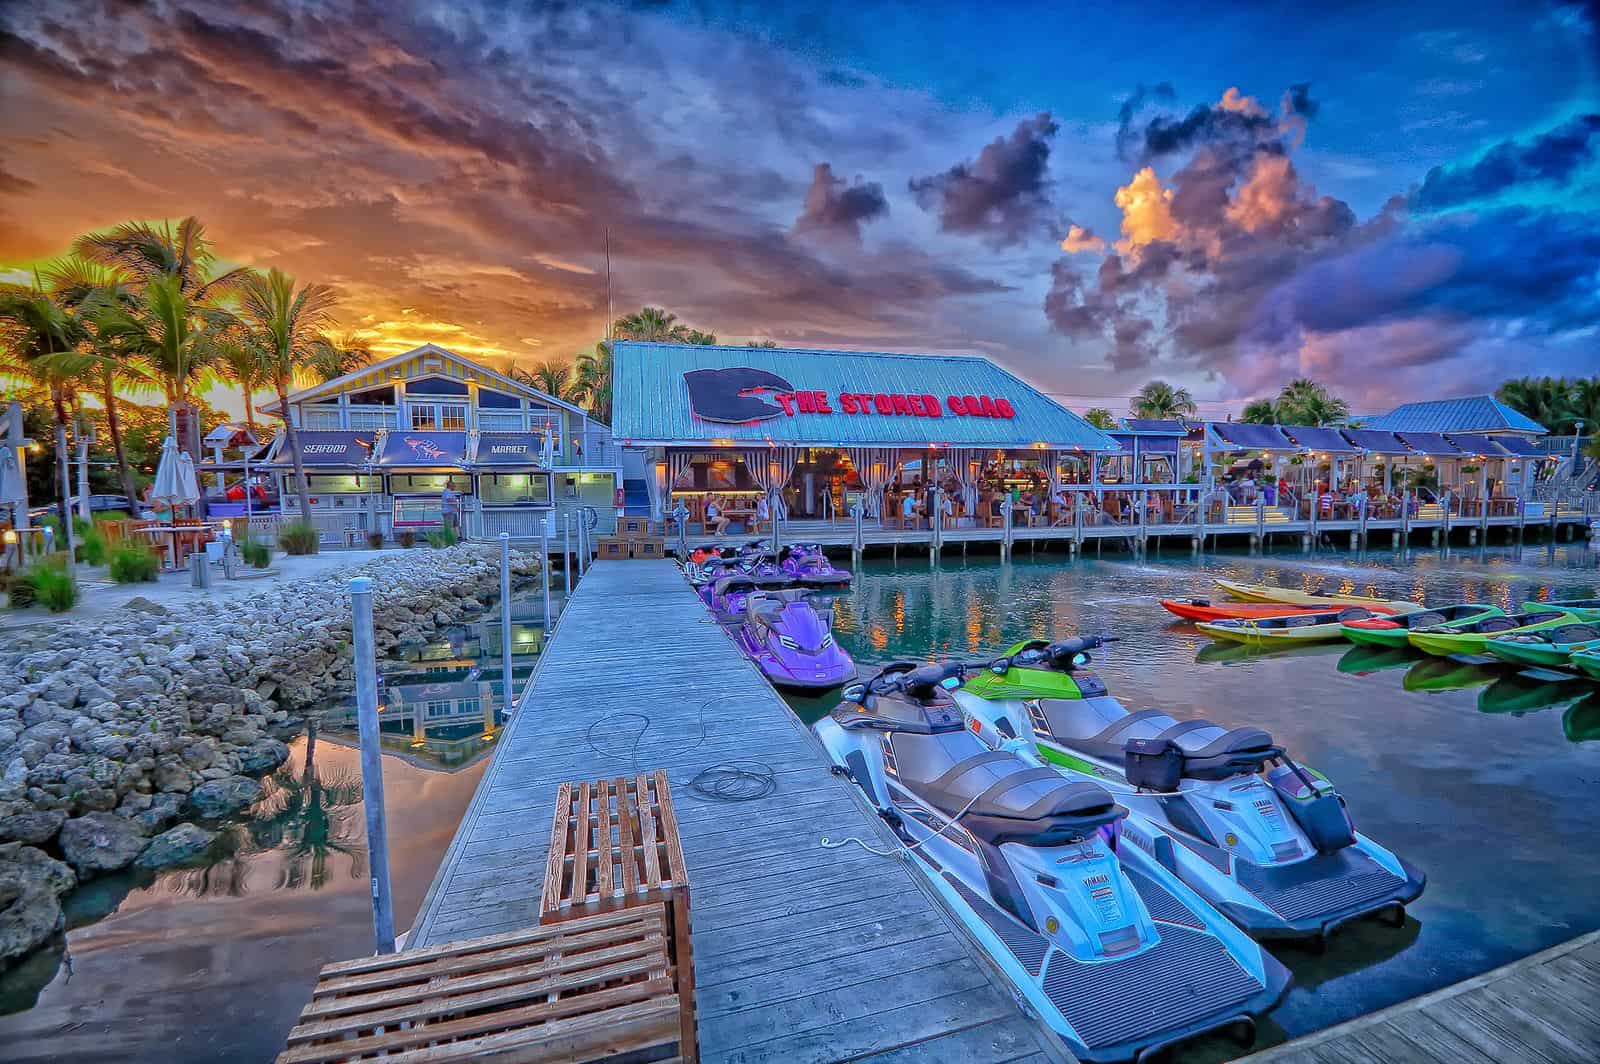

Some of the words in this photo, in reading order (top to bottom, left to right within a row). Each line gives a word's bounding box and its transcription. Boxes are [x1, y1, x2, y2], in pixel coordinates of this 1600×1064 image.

[774, 389, 833, 417] THE
[839, 392, 942, 418] STONED
[947, 395, 1016, 419] CRAB
[303, 444, 347, 454] SEAFOOD
[491, 445, 528, 454] MARKET
[1083, 874, 1110, 887] YAMAHA
